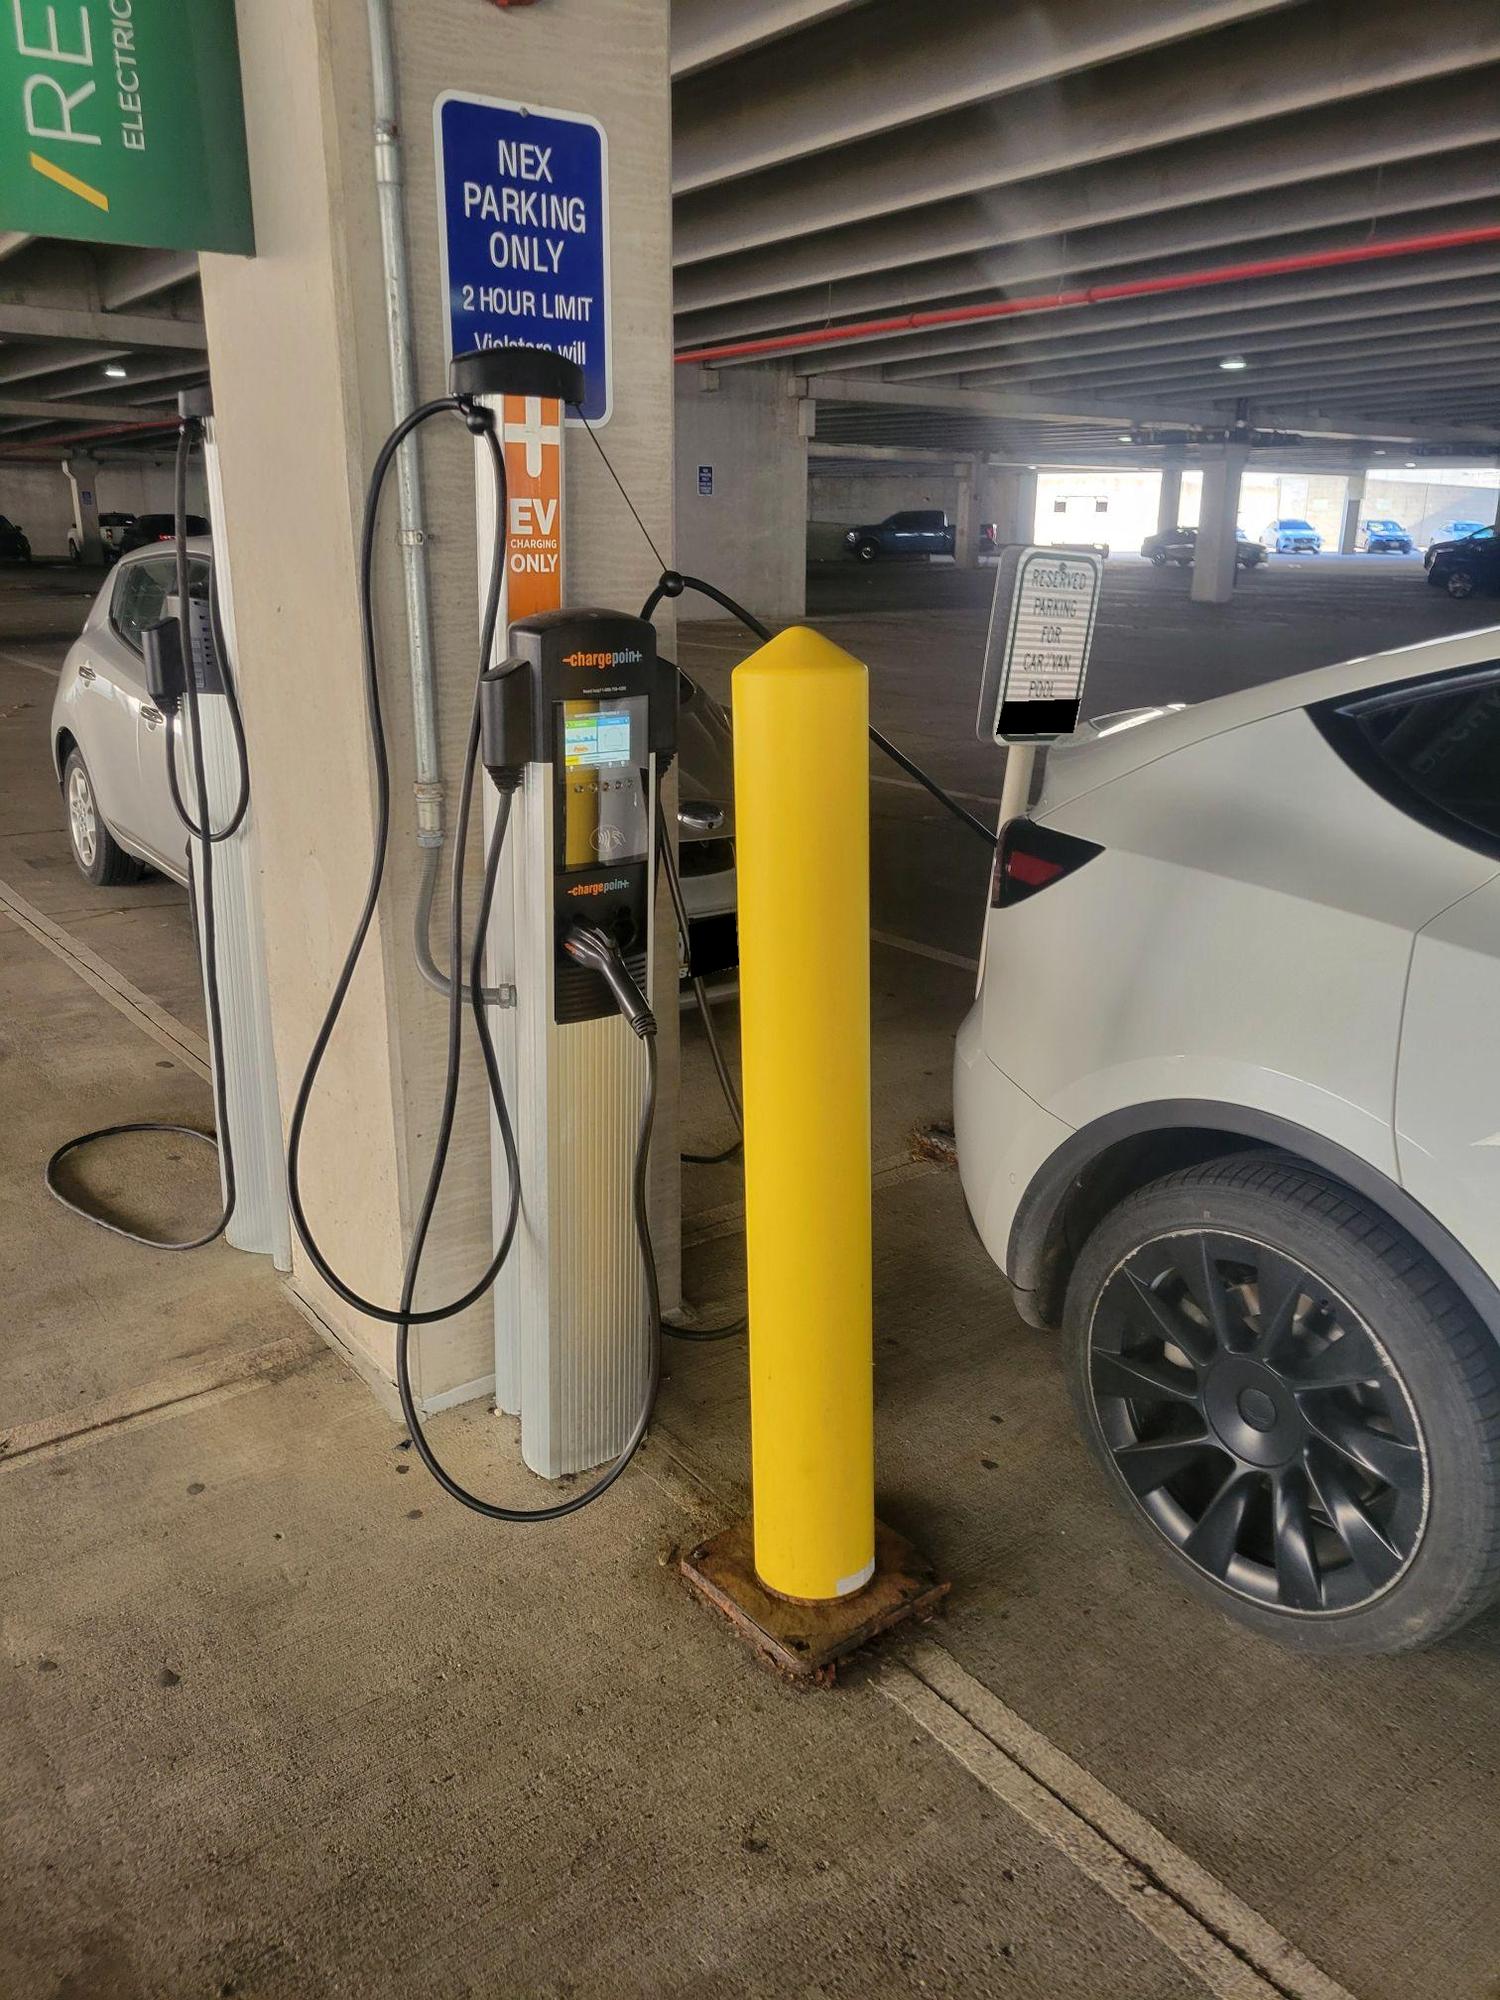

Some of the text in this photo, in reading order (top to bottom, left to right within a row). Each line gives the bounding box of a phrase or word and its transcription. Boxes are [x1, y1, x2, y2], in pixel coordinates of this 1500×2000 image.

[498, 139, 553, 184] NEX
[463, 181, 586, 234] PARKING
[489, 231, 565, 274] ONLY
[462, 284, 593, 322] 2 HOUR LIMIT
[557, 340, 586, 366] will
[510, 498, 558, 535] EV
[510, 538, 557, 549] CHARGING
[510, 553, 558, 573] ONLY
[1031, 568, 1087, 591] RESERVED
[1032, 597, 1077, 619] PARKING
[1041, 625, 1063, 644] FOR
[1028, 680, 1055, 699] POOL
